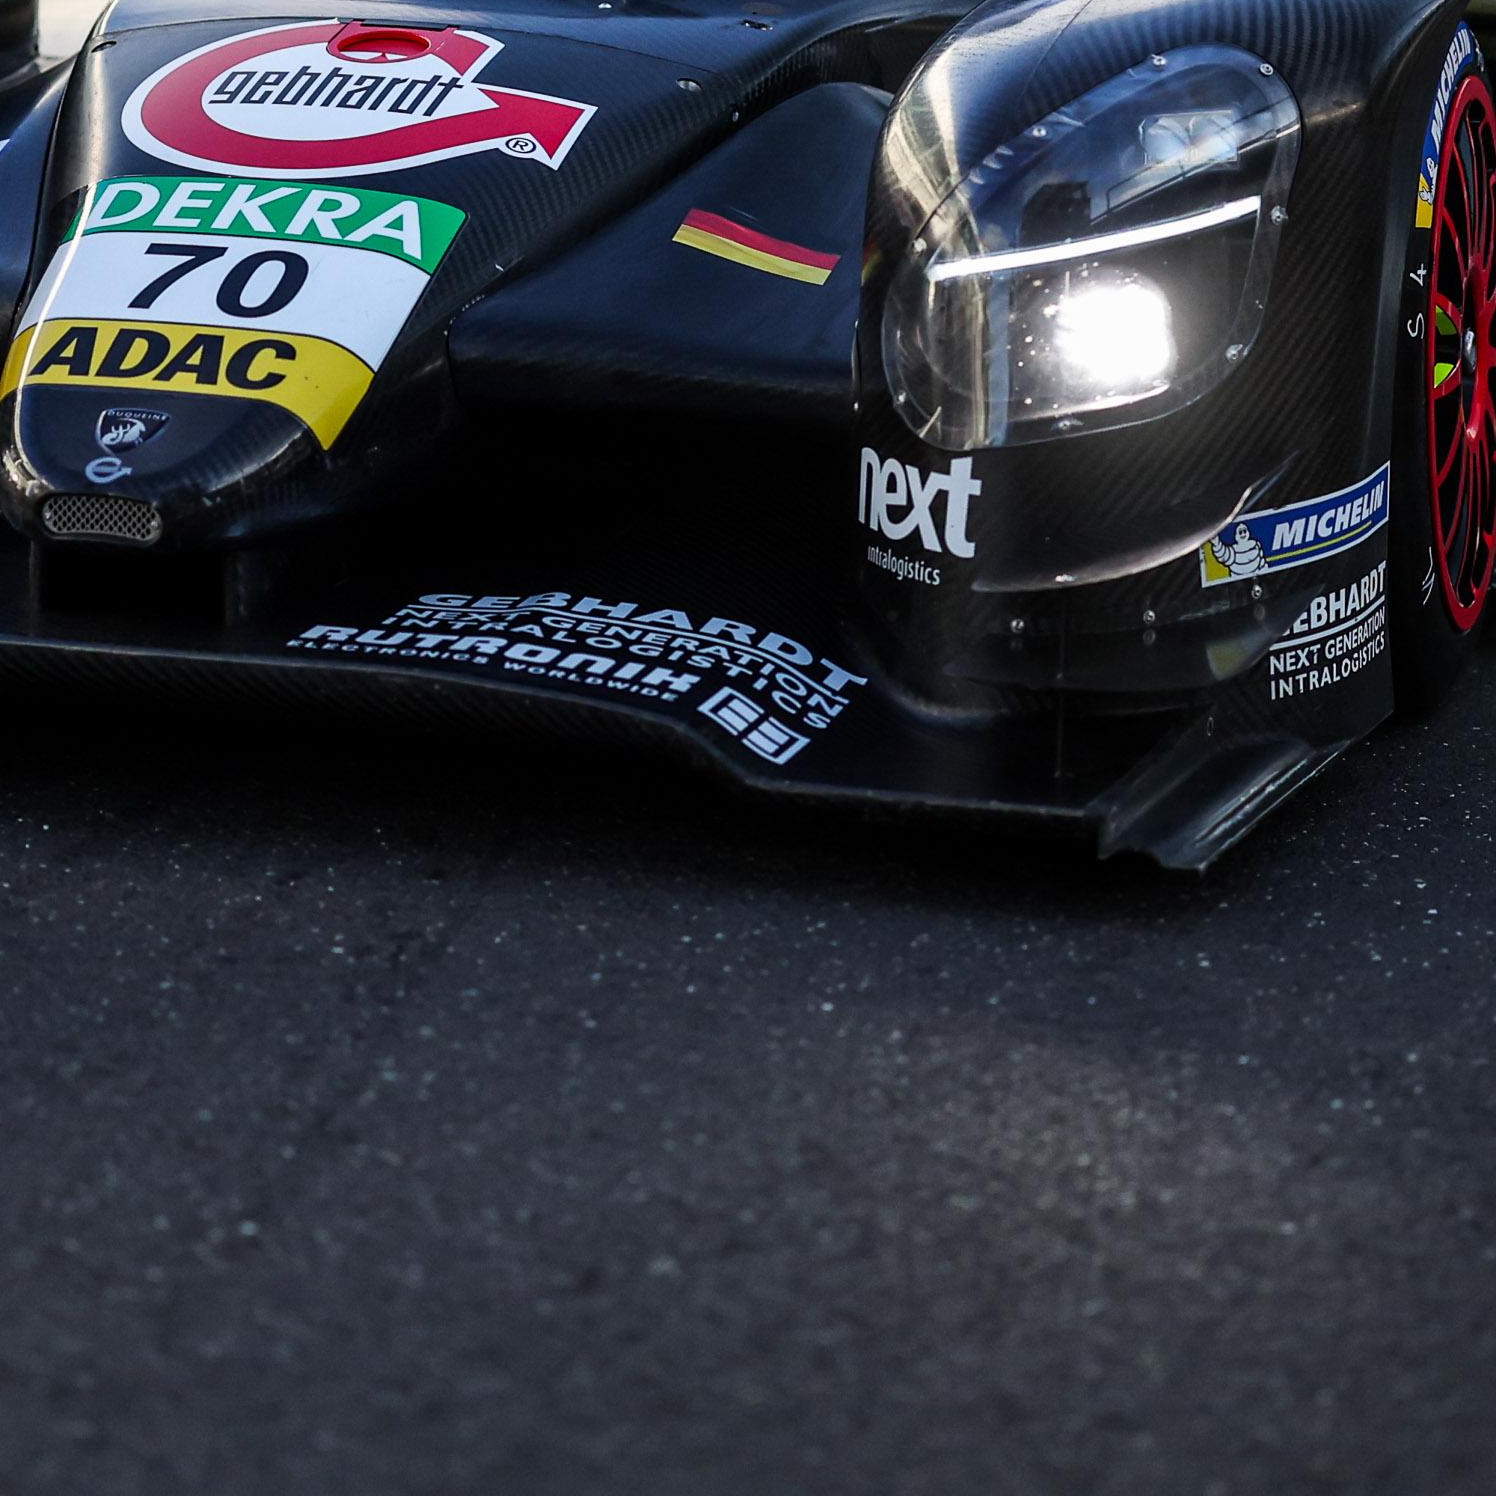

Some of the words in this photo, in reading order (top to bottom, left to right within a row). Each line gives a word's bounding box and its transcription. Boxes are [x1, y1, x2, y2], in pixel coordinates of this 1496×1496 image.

[208, 65, 468, 117] gebhardt
[1430, 28, 1471, 155] MICHELIN
[87, 181, 424, 261] DEKRA
[127, 242, 310, 319] 70
[29, 325, 297, 391] ADAC
[857, 446, 983, 559] next
[1271, 480, 1385, 551] MICHELIN
[867, 545, 941, 586] intralogistics
[1282, 559, 1387, 637] EBHARDT
[286, 639, 490, 665] ELECTRONICS
[503, 661, 682, 703] WORLDWIDE
[299, 624, 703, 694] RUTRONIK
[381, 616, 832, 730] INTRALOGISTICS
[395, 608, 531, 622] NEXT
[541, 616, 844, 718] GENERATION
[418, 591, 868, 692] GEBHARDT
[1269, 643, 1321, 676] NEXT
[1324, 605, 1386, 660] GENERATION
[1270, 630, 1386, 701] INTRALOGISTICS
